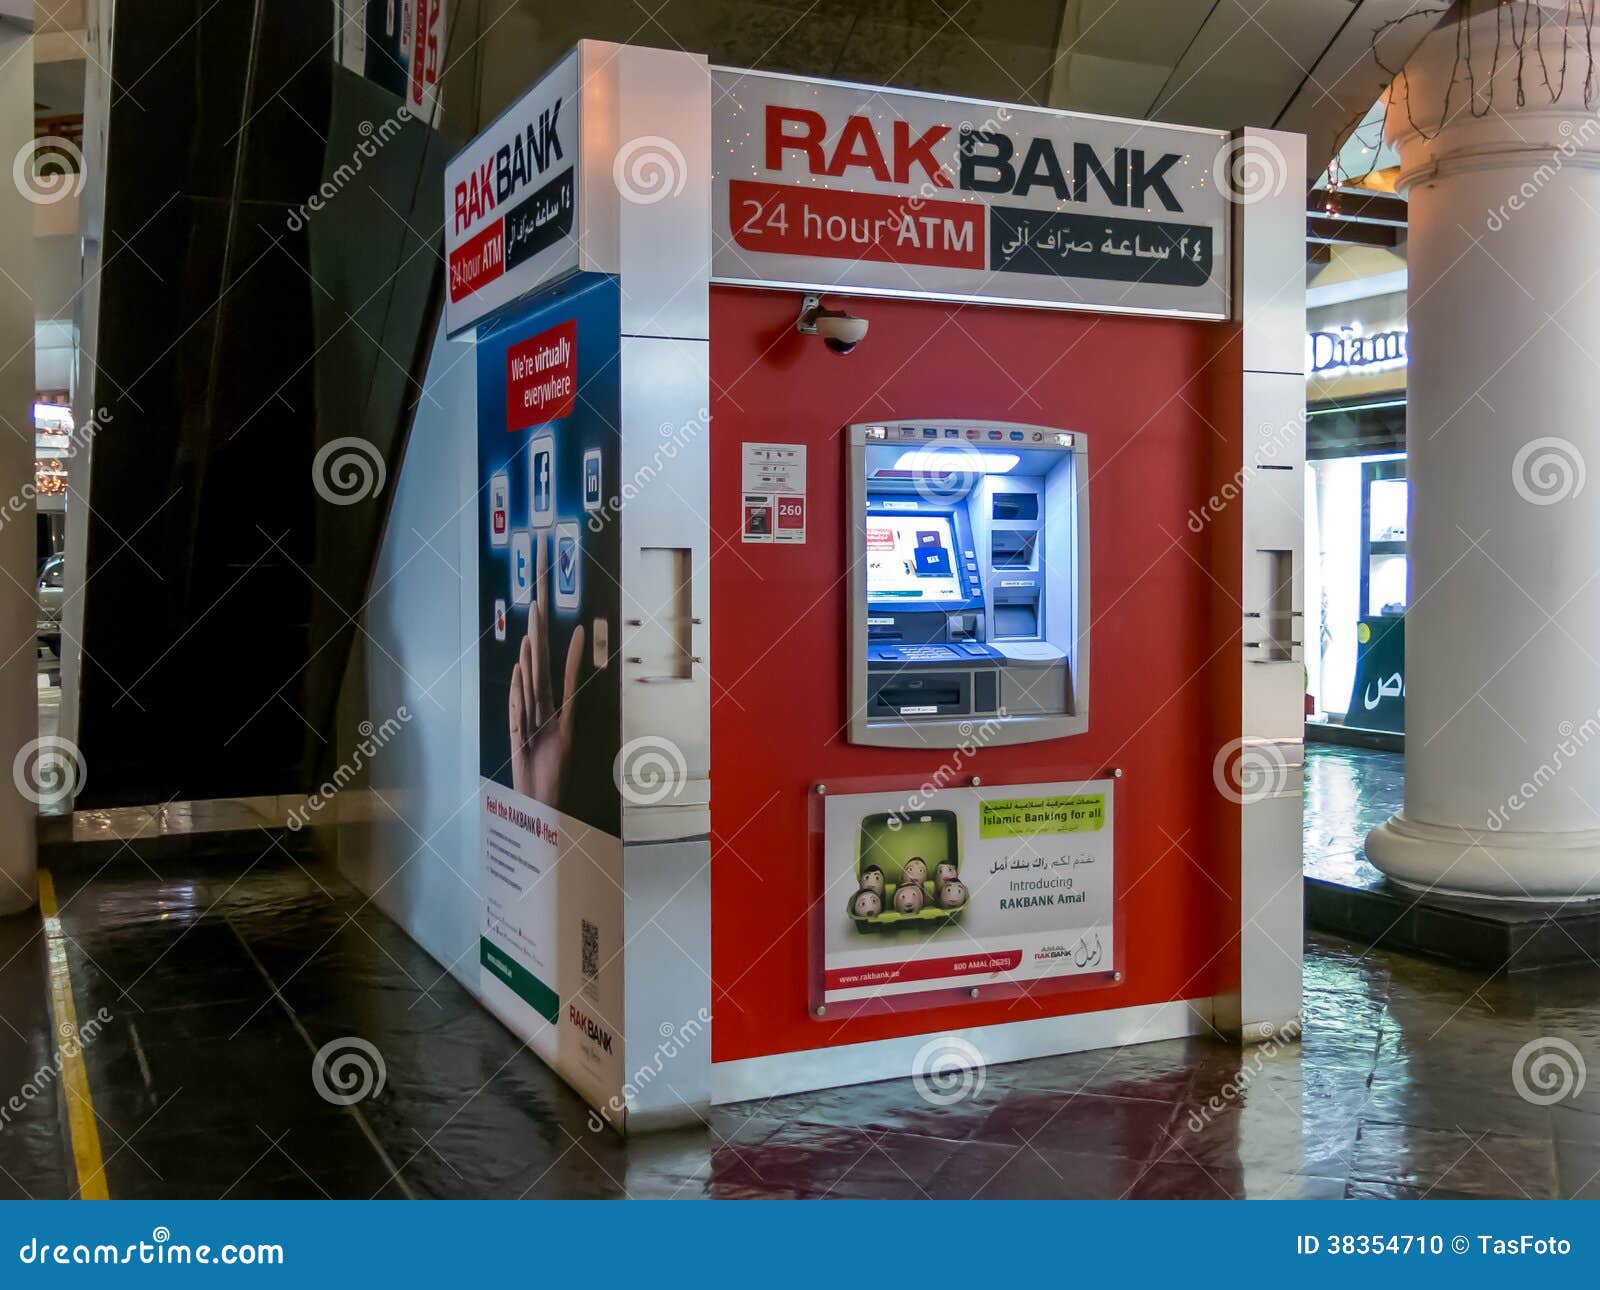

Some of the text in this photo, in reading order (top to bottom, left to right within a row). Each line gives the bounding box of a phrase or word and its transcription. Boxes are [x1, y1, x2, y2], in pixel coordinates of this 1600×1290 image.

[454, 96, 564, 236] RAKBANK
[764, 104, 1185, 213] RAKBANK
[742, 198, 974, 253] 24 hour ATM
[1101, 228, 1170, 260] ساعة
[451, 233, 502, 291] 24 hour ATM
[511, 336, 571, 382] We're virtually
[1309, 325, 1408, 373] Diam
[524, 374, 571, 410] everywhere
[588, 468, 598, 493] in
[779, 505, 802, 516] 260
[498, 800, 507, 820] the
[508, 806, 535, 836] RAKBANK
[983, 807, 1101, 826] Islamic Banking for all
[999, 891, 1086, 910] RAKBANK Amal
[1009, 877, 1074, 891] Introducing
[953, 962, 967, 971] 800
[968, 960, 989, 969] AMAL
[1034, 950, 1072, 960] RAKBANK
[839, 970, 900, 983] www.rakbank.ae
[569, 1004, 613, 1056] RAKBANK
